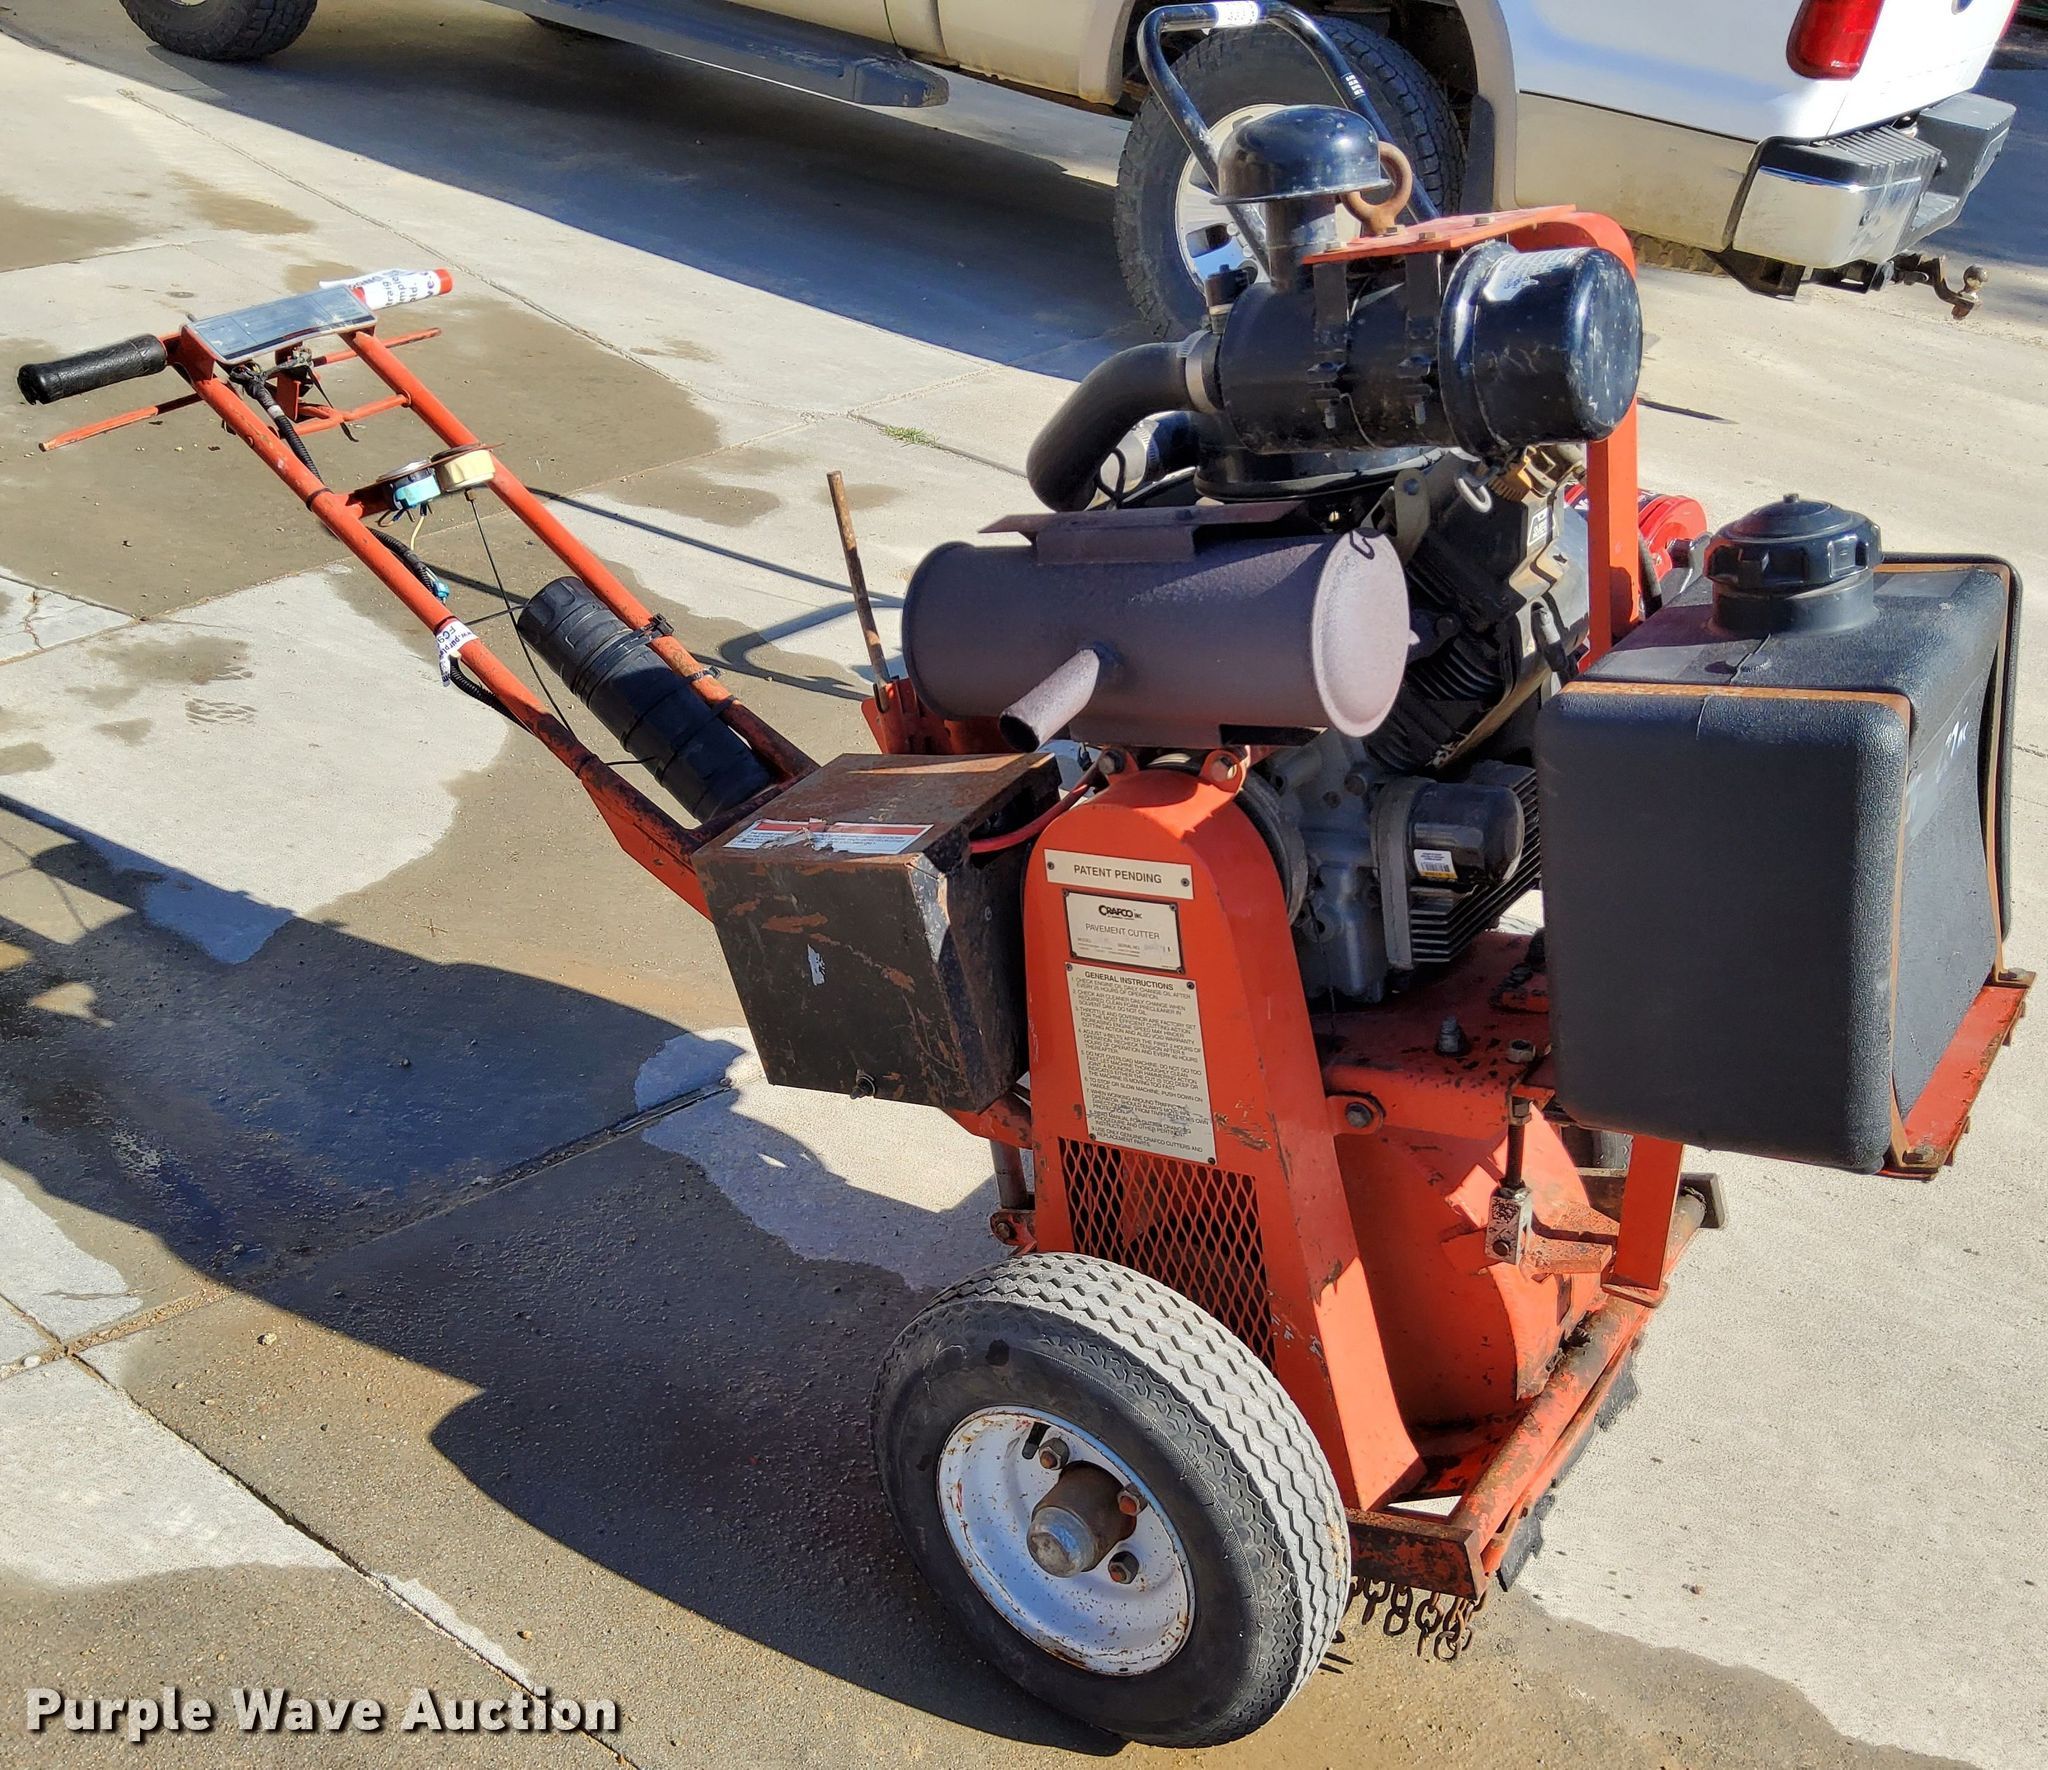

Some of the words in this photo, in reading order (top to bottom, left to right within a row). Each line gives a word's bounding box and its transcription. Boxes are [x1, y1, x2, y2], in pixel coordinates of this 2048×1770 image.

[1074, 864, 1111, 878] PATENT
[1114, 870, 1162, 884] PENDING
[1098, 904, 1134, 918] CRAFCO
[1085, 923, 1126, 937] PAVEMENT
[1128, 929, 1160, 940] CUTTER
[1084, 970, 1119, 982] GENERAL
[1119, 976, 1173, 990] INSTRUCTIONS
